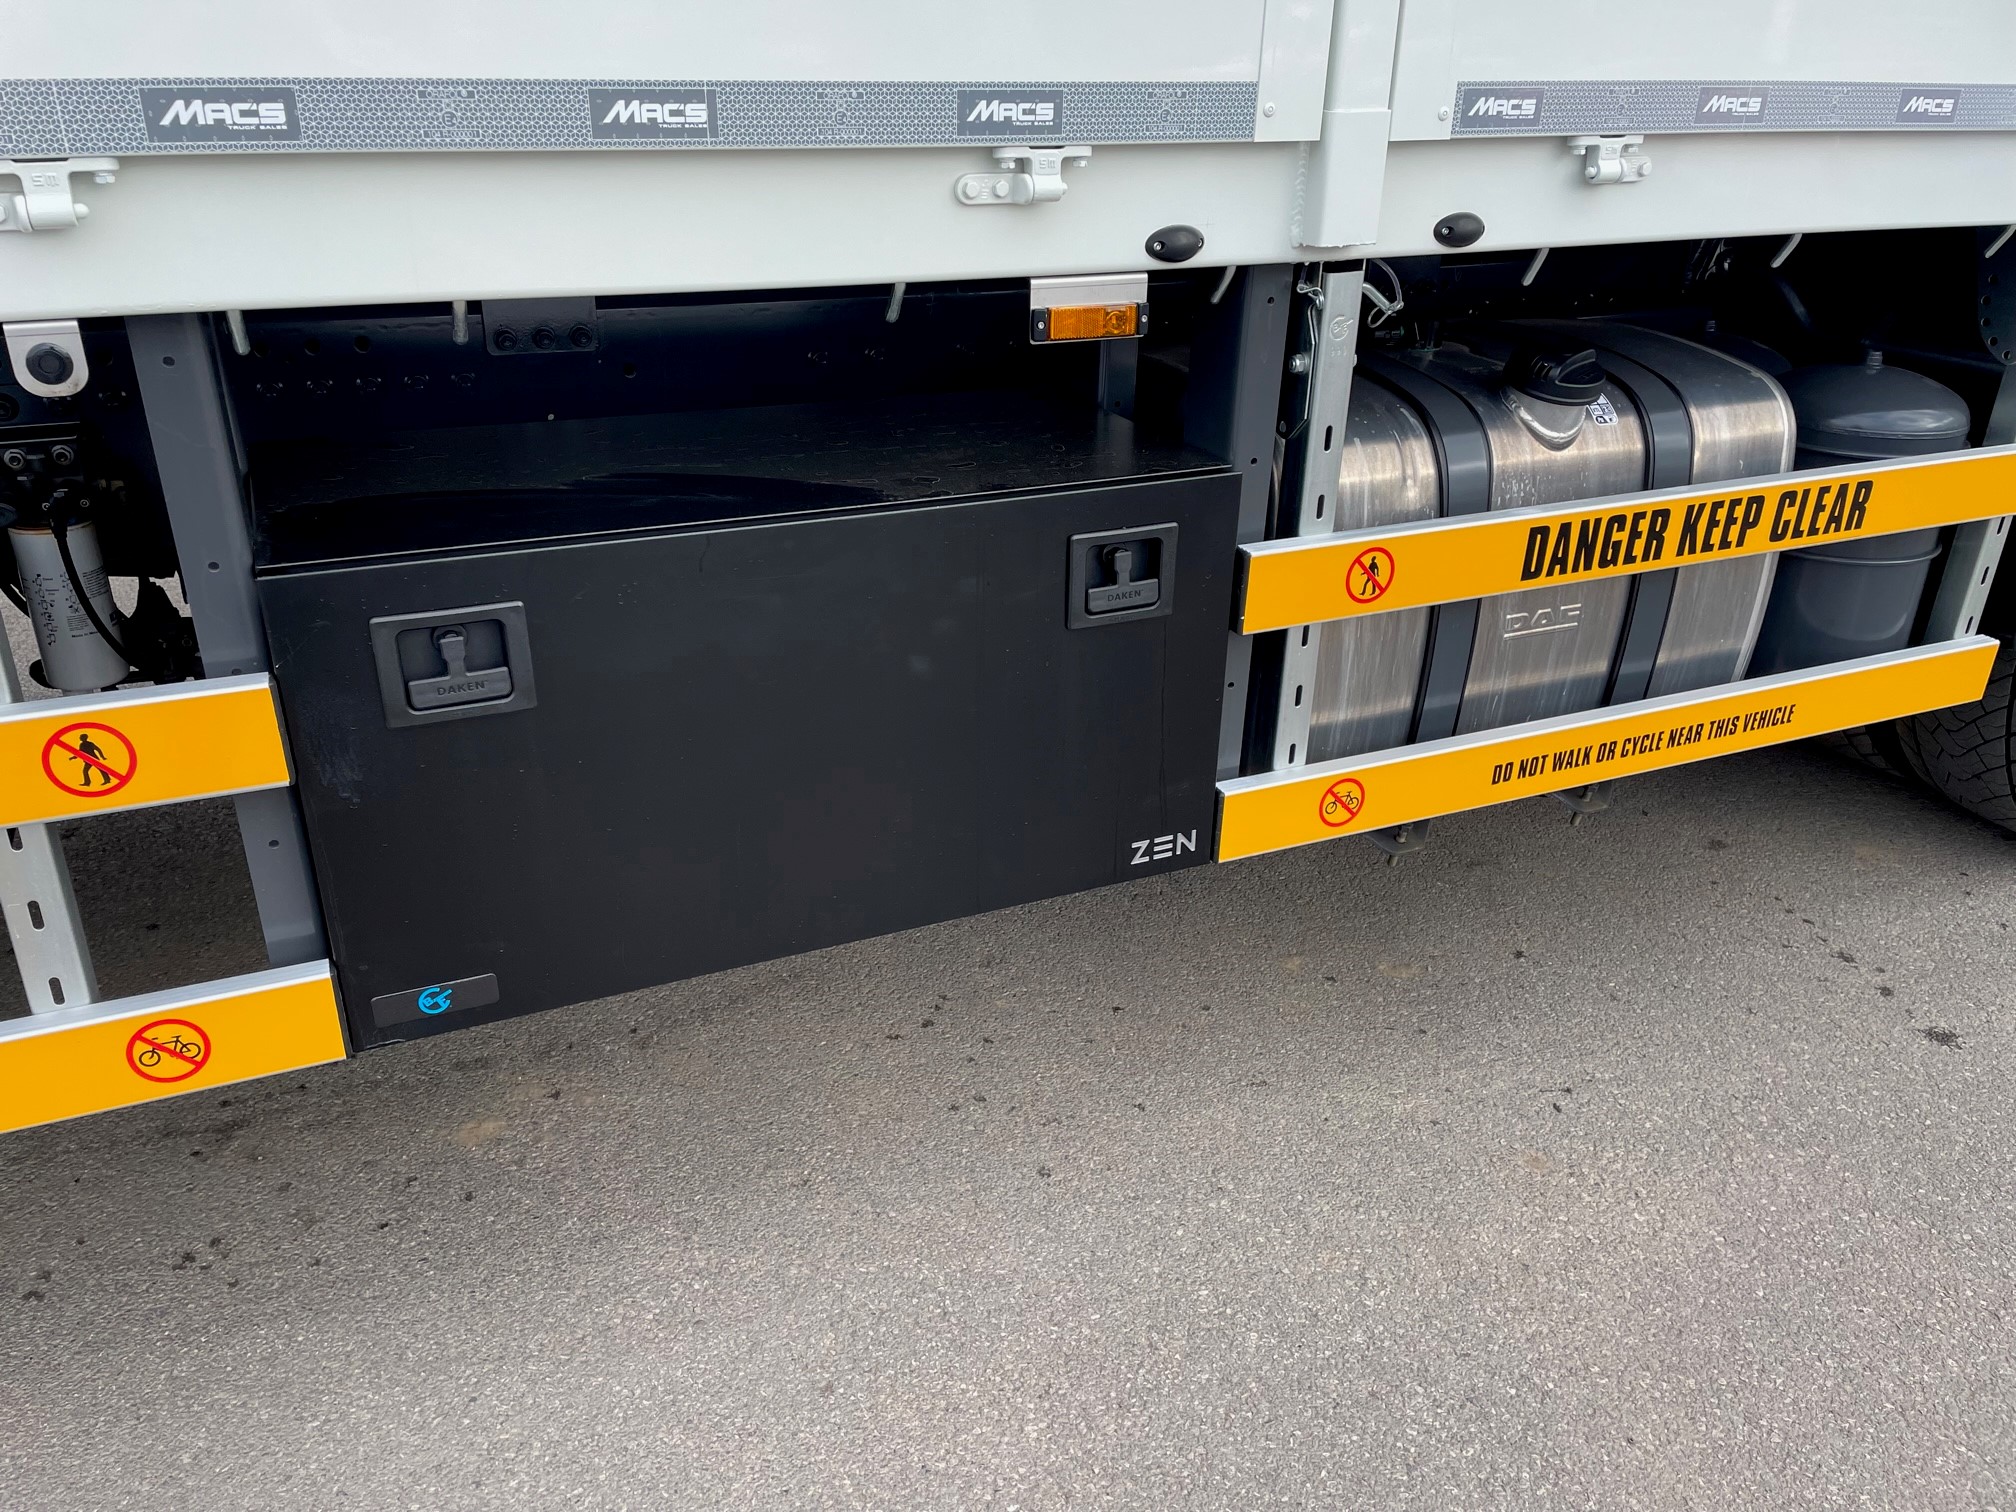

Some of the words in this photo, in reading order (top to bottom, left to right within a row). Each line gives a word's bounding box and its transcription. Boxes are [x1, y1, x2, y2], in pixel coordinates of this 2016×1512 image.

[1520, 508, 1671, 582] DANGER
[1675, 495, 1766, 557] KEEP
[1769, 480, 1874, 543] CLEAR
[1107, 590, 1142, 602] DAKEN
[1505, 603, 1582, 632] DAF
[437, 680, 486, 696] DAKEN
[1491, 761, 1514, 785] DO
[1517, 754, 1549, 780] NOT
[1552, 745, 1593, 772] WALK
[1596, 740, 1617, 763] OR
[1620, 731, 1665, 758] CYCLE
[1666, 723, 1704, 749] NEAR
[1707, 715, 1740, 740] THIS
[1743, 704, 1796, 733] VEHICLE
[1130, 829, 1197, 865] ZEN
